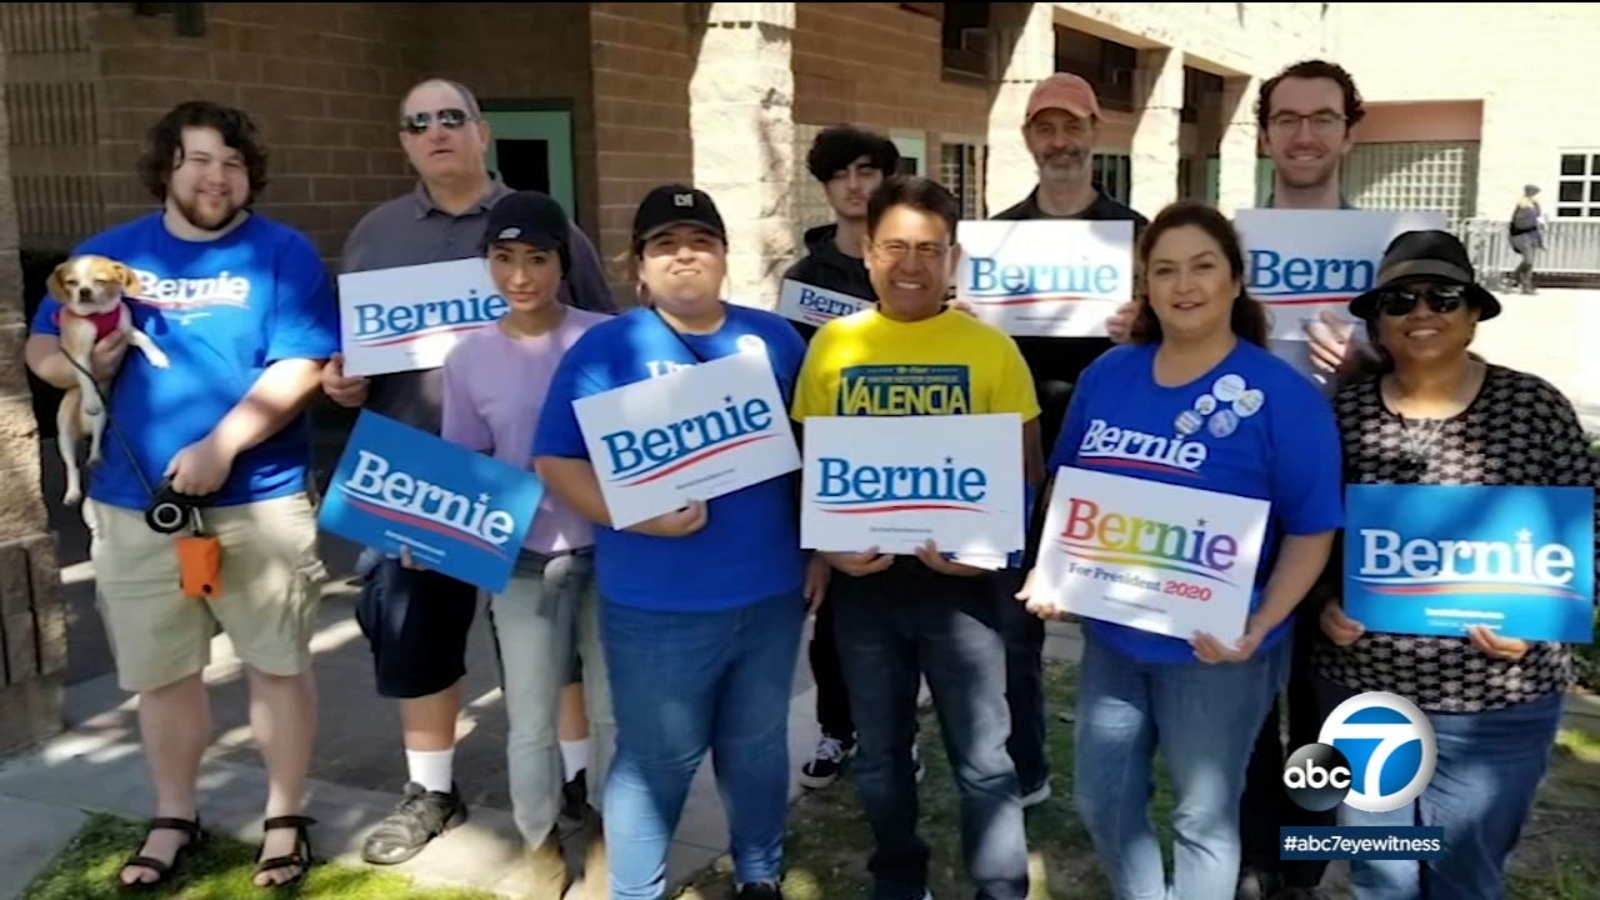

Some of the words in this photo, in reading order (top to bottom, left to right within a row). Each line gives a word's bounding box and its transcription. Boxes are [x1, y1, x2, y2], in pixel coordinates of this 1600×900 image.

[133, 268, 250, 302] Bernie
[969, 255, 1119, 294] Bernie
[1248, 249, 1375, 292] Bern
[354, 289, 511, 337] Bernie
[841, 376, 968, 416] VALENCIA
[600, 396, 773, 475] Bernie
[1080, 419, 1207, 470] Bernie
[346, 450, 514, 545] Bernie
[816, 457, 987, 502] Bernie
[1061, 497, 1238, 572] Bernie
[1359, 528, 1576, 585] Bernie
[1069, 562, 1092, 577] For
[1093, 567, 1161, 591] President
[1163, 580, 1213, 602] 2020
